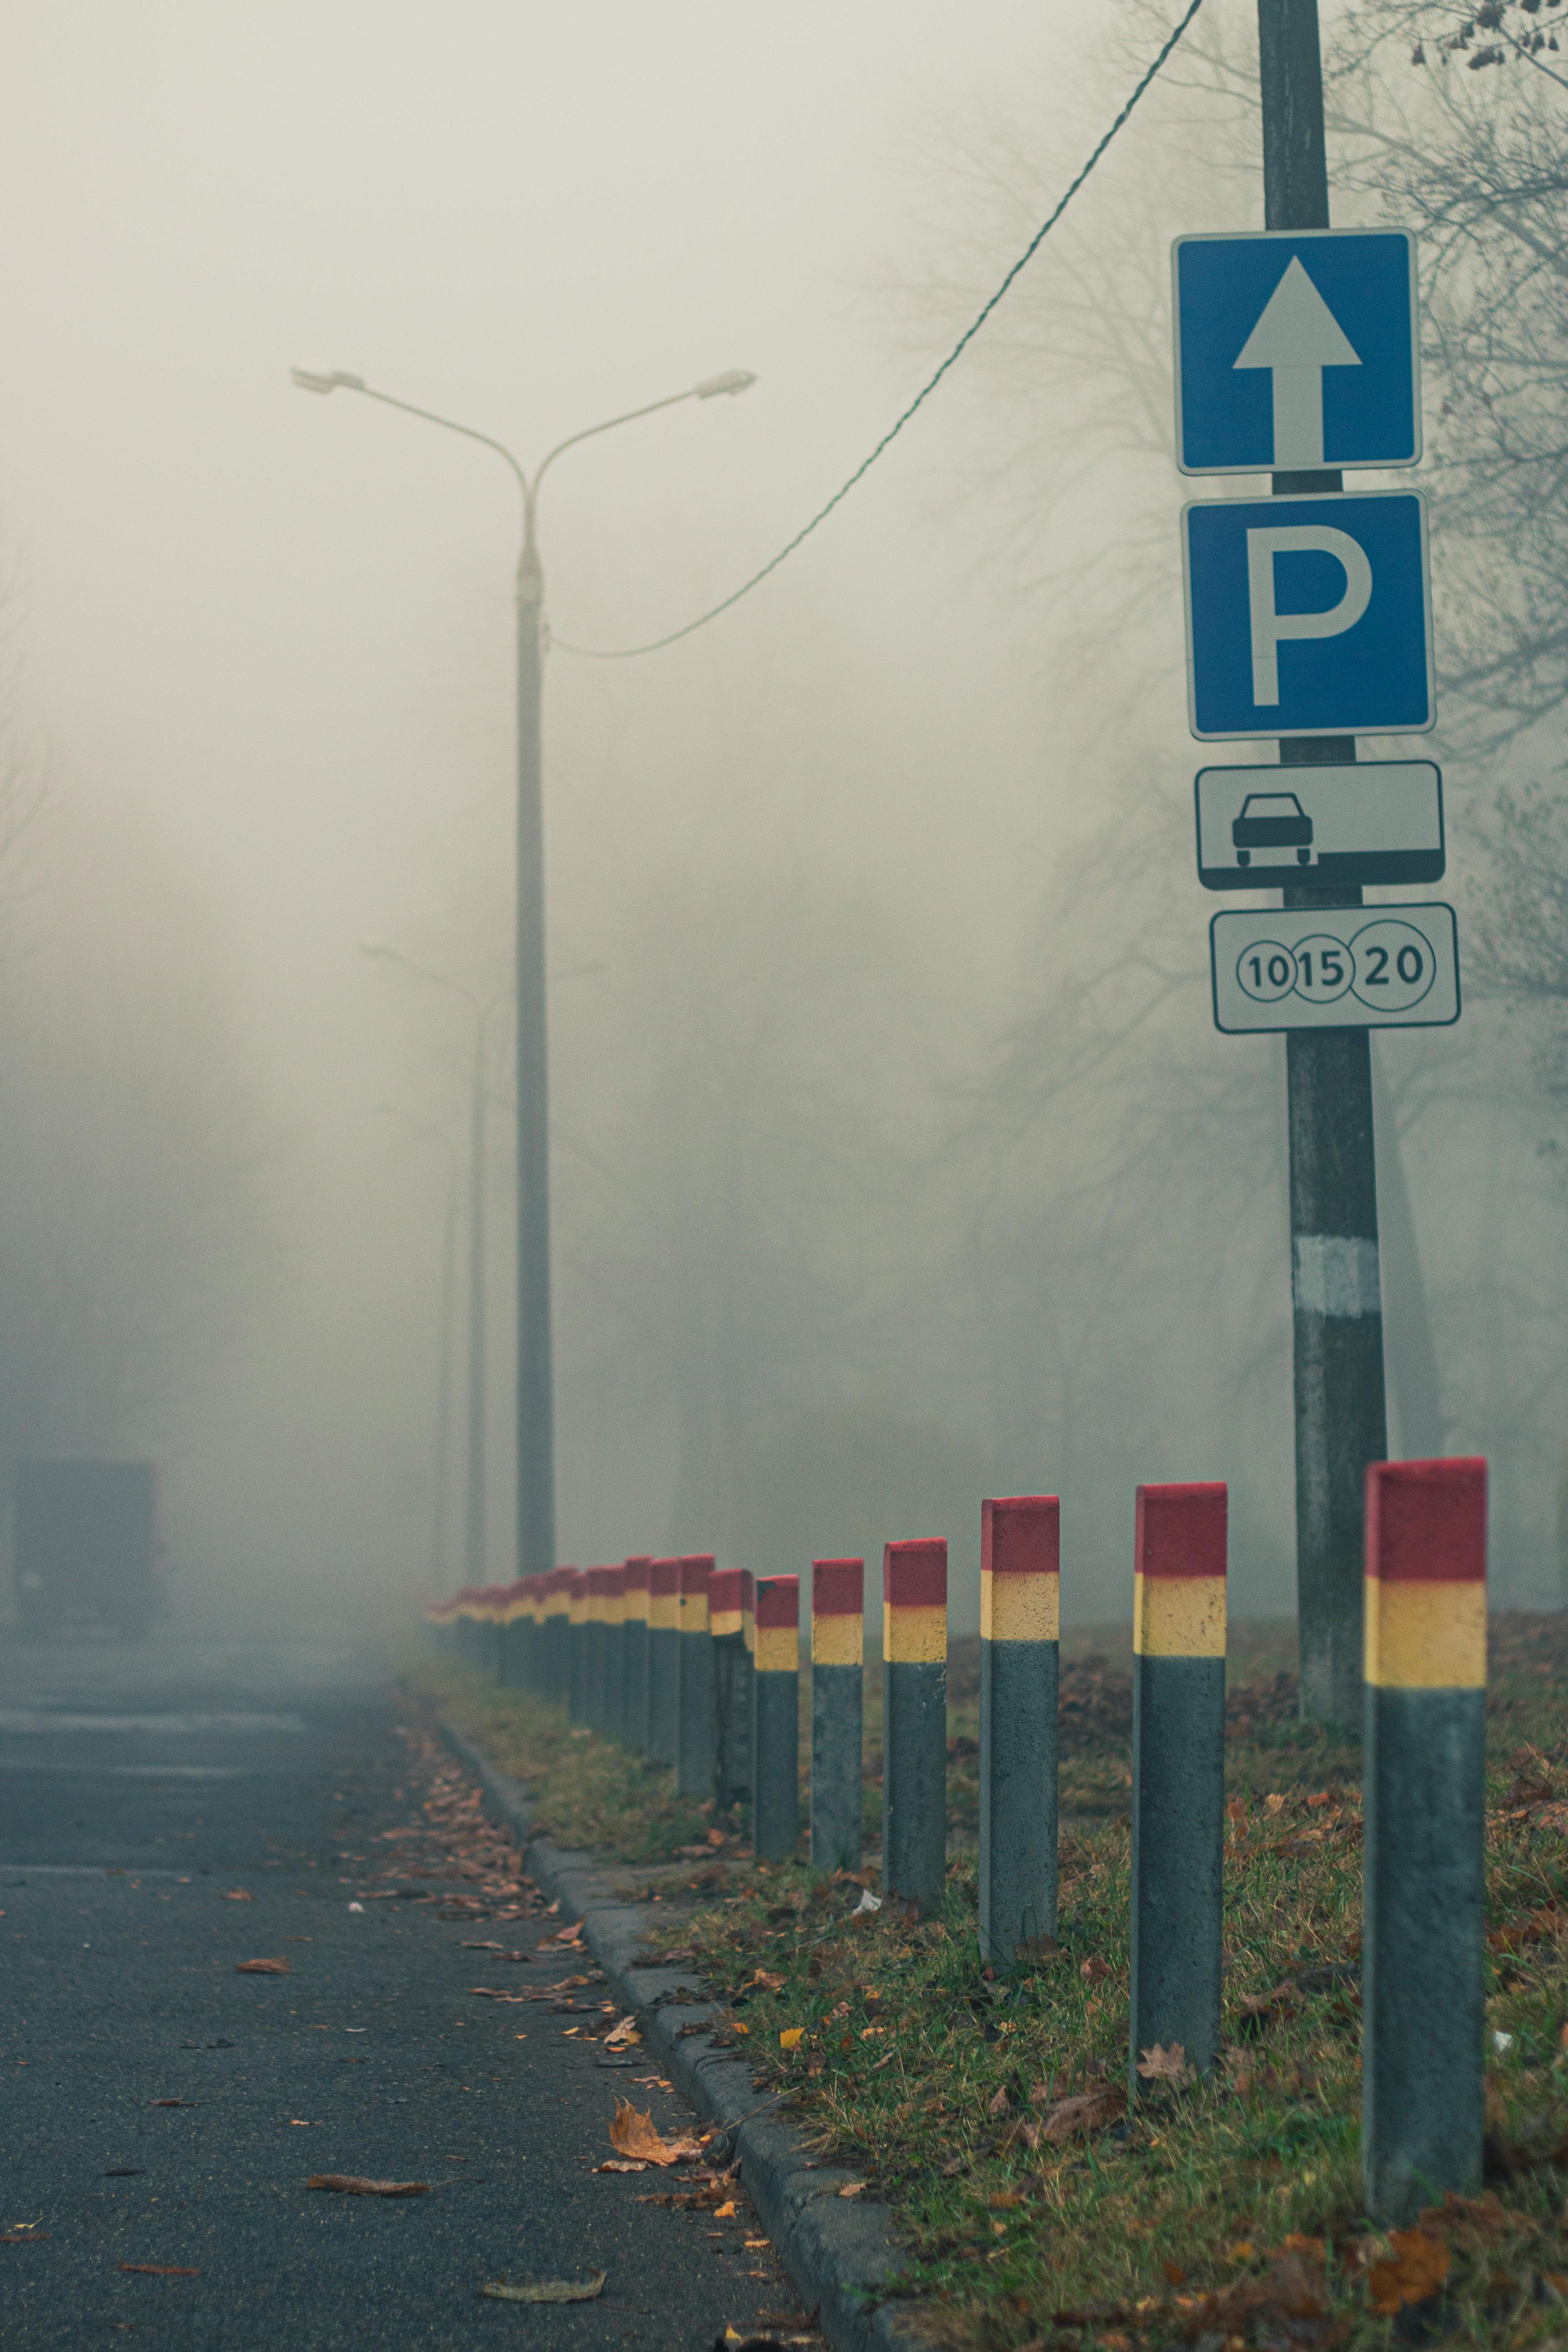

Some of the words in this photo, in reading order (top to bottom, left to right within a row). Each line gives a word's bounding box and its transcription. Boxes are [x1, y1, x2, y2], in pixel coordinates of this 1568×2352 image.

[1246, 524, 1373, 707] P
[1249, 955, 1290, 987] 10
[1298, 950, 1344, 987] 15
[1365, 944, 1424, 985] 20
